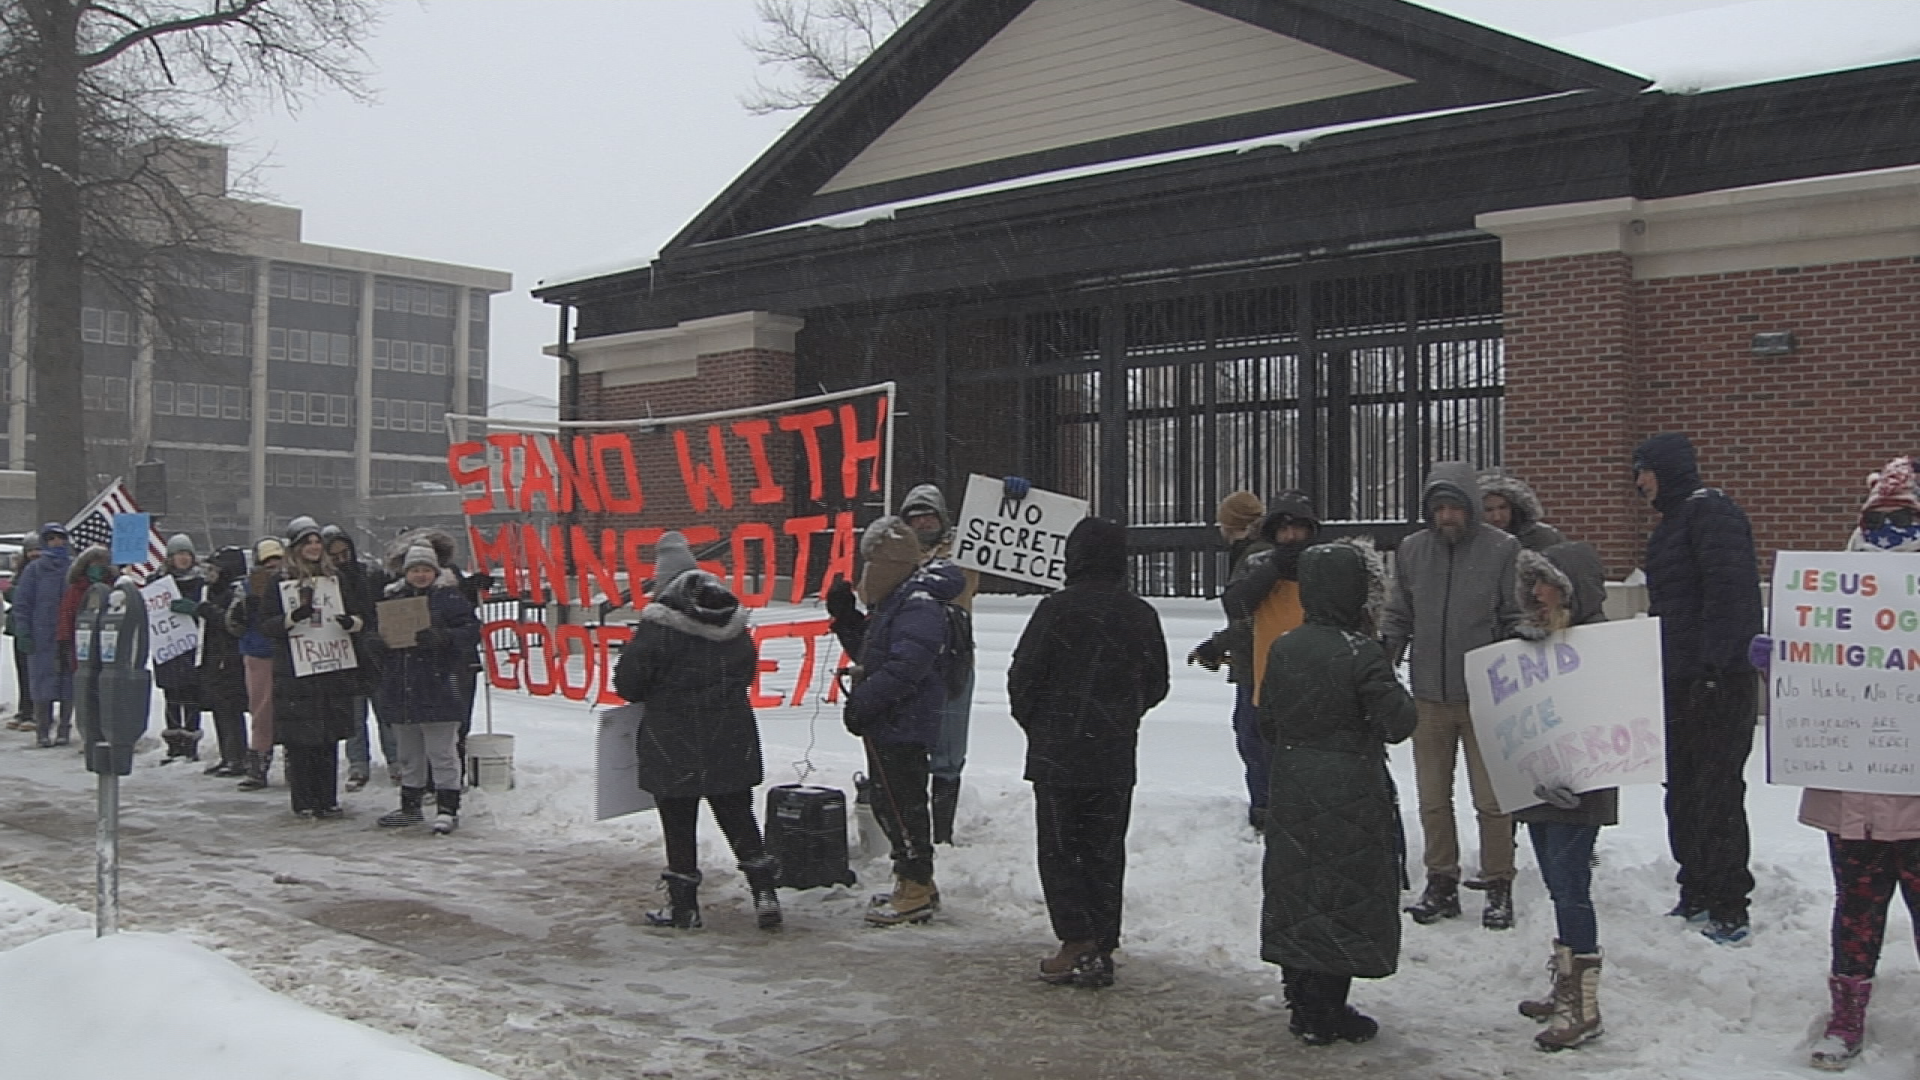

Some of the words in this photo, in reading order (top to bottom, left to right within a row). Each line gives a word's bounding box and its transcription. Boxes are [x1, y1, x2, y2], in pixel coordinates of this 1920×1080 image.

[448, 432, 644, 514] STAND
[674, 396, 888, 512] WITH
[999, 497, 1042, 525] NO
[966, 518, 1066, 555] SECRET
[957, 540, 1066, 580] POLICE
[1785, 569, 1879, 597] JESUS
[1905, 574, 1920, 596] I
[151, 615, 180, 636] ICE
[1794, 605, 1852, 631] THE
[1874, 608, 1918, 632] OG
[157, 633, 198, 661] GOOD
[289, 633, 350, 662] TRUMP
[1779, 639, 1920, 671] IMMIGRAN
[1487, 642, 1582, 706] END
[1776, 674, 1800, 699] No
[1863, 682, 1887, 701] No
[1895, 683, 1920, 704] Fe
[1494, 695, 1564, 761] ICE
